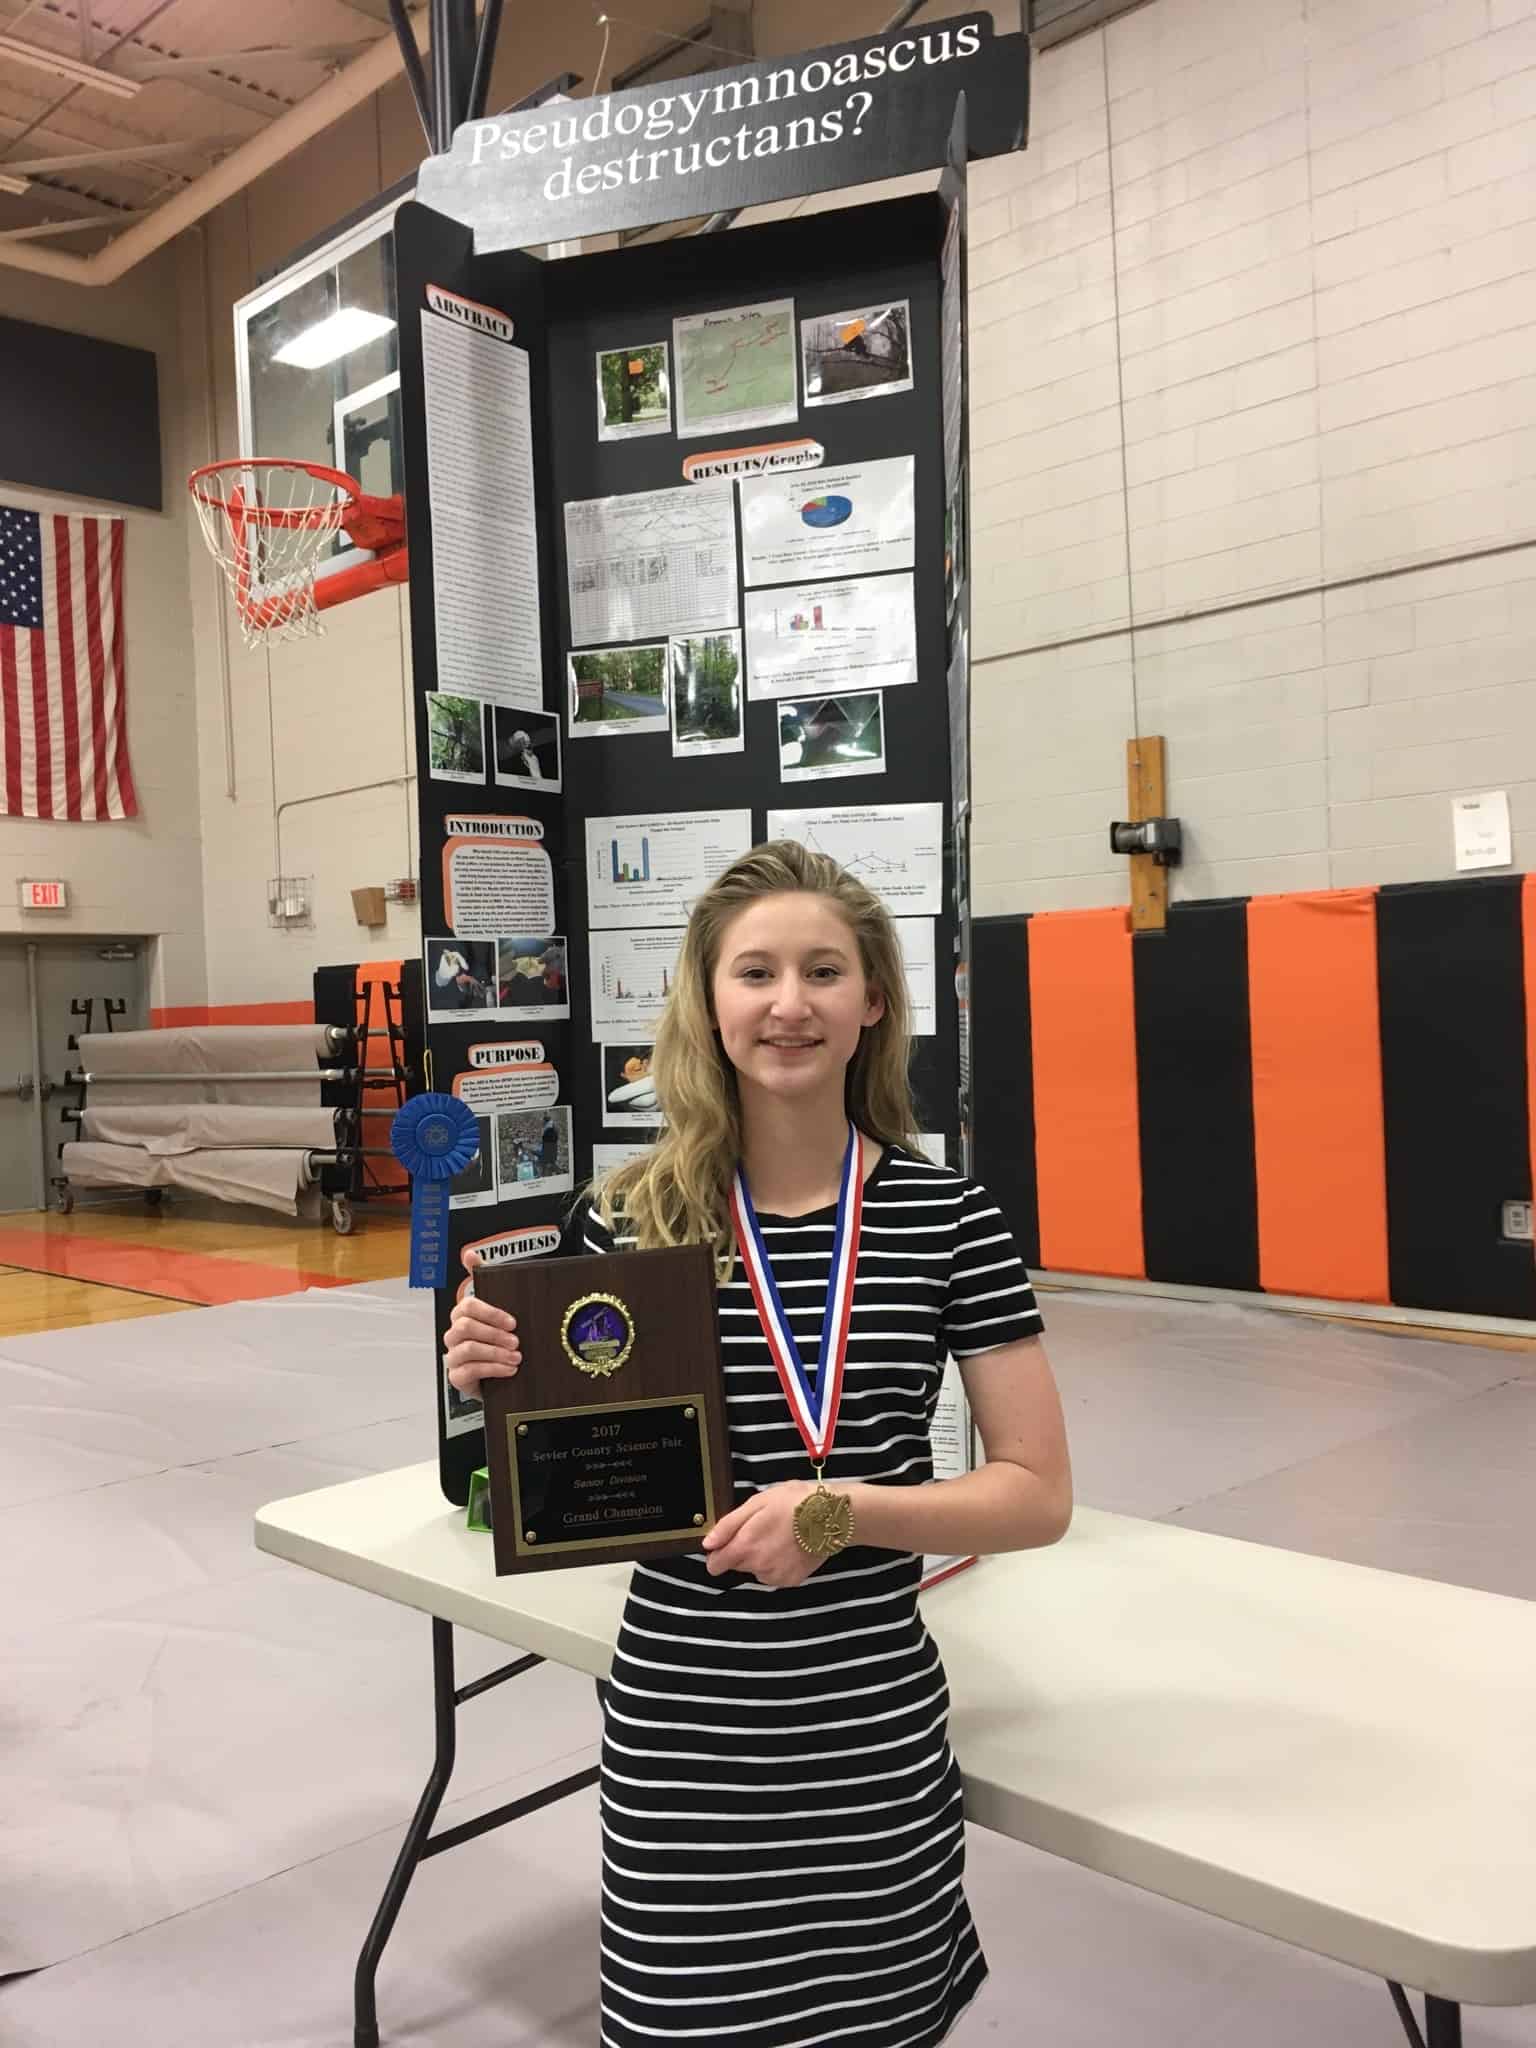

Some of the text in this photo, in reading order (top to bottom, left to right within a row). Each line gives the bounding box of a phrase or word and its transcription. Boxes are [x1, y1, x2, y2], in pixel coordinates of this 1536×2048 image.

[468, 22, 982, 166] Pseudogymnoascus
[542, 90, 874, 202] destructans?
[432, 294, 511, 338] ABSTRACT
[692, 449, 821, 480] RESULTS/Graphs
[449, 820, 542, 836] INTRODUCTION
[32, 884, 59, 905] EXIT
[474, 1046, 542, 1065] PURPOSE
[475, 1232, 558, 1261] YPOTHESIS
[591, 1424, 624, 1438] 2017
[532, 1436, 683, 1463] Sevier County Science Fair
[562, 1503, 664, 1524] Grand Champion
